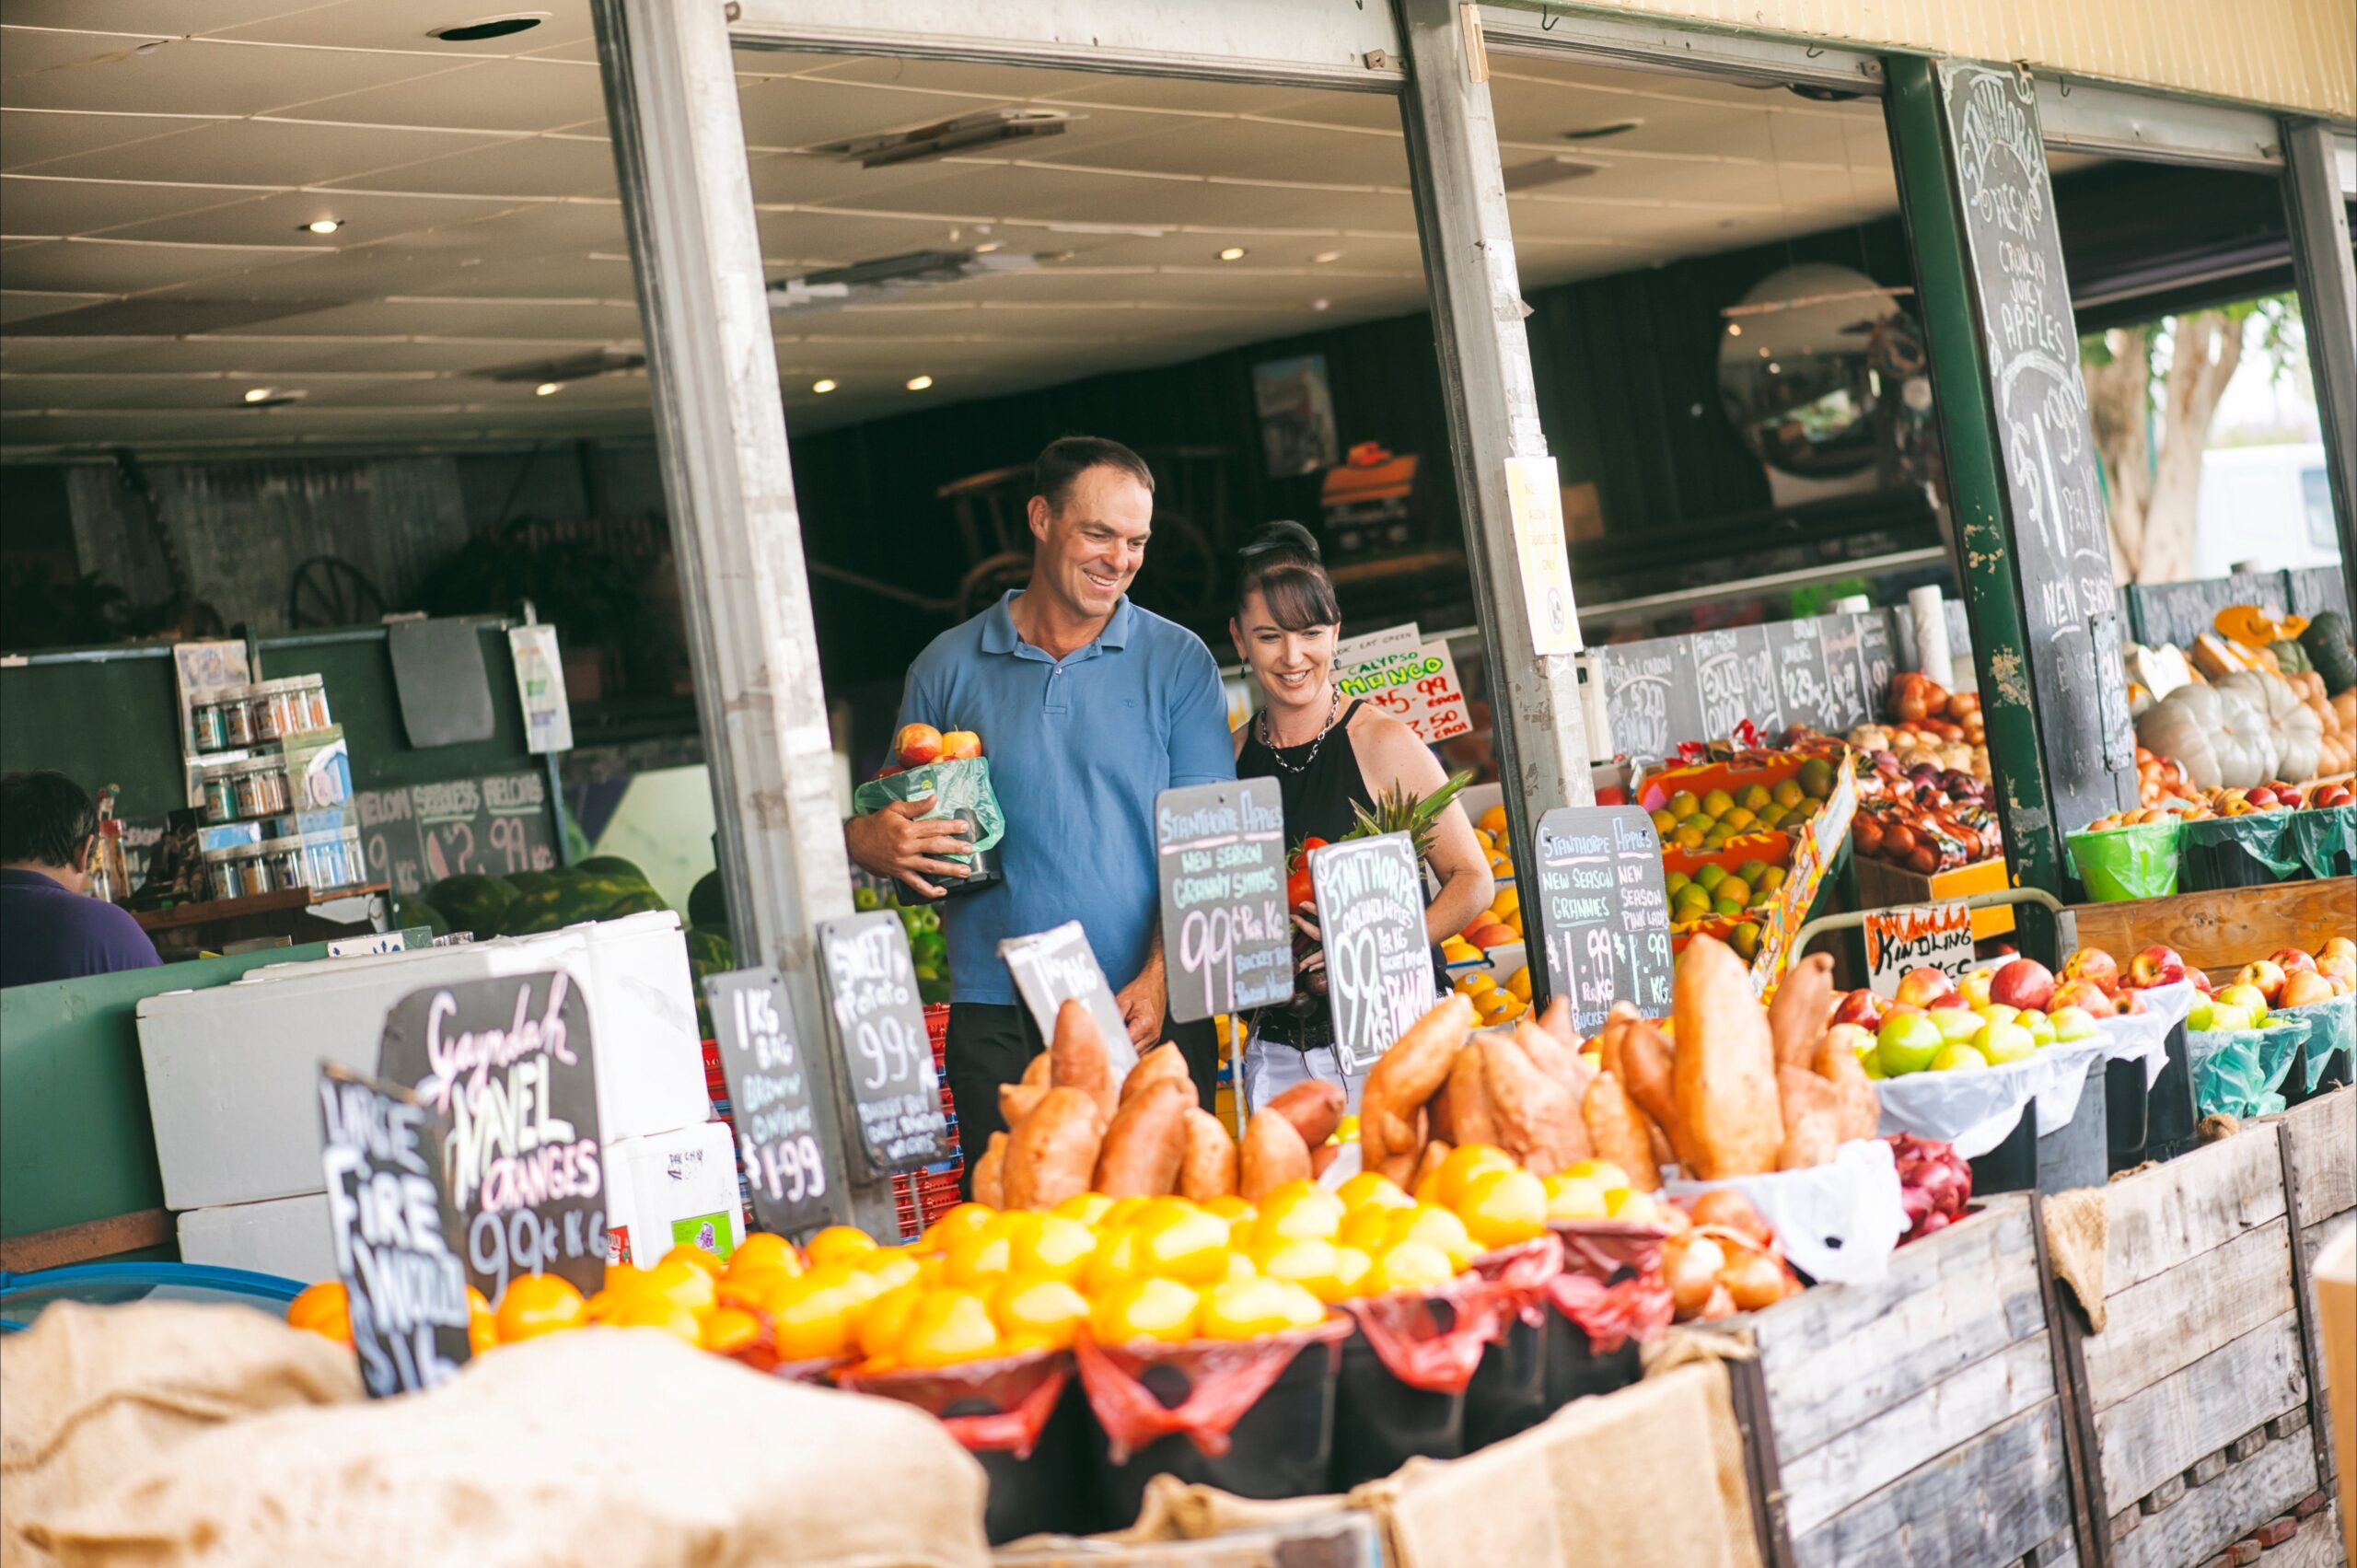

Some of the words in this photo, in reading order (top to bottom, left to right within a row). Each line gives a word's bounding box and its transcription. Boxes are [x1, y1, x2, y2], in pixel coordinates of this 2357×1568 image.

[2010, 278, 2043, 314] JUICY
[2001, 303, 2067, 363] APPLES
[2042, 575, 2080, 627] NEW
[1339, 656, 1444, 697] MANGO
[1348, 651, 1418, 675] CALYPSO
[1539, 827, 1611, 858] STANTHORPE
[1612, 817, 1654, 851] APPLES
[1181, 850, 1212, 874] NEW
[1542, 871, 1570, 891] NEW
[1573, 867, 1614, 889] SEASON
[1618, 865, 1643, 885] NEW
[1551, 896, 1610, 920] GRANNIES
[1620, 887, 1663, 908] SEASON
[1620, 908, 1646, 932] PINK
[1874, 927, 1971, 976] KINDLING
[482, 1138, 601, 1213] ORANGES
[322, 1144, 447, 1275] FIRE
[563, 1209, 609, 1259] KG
